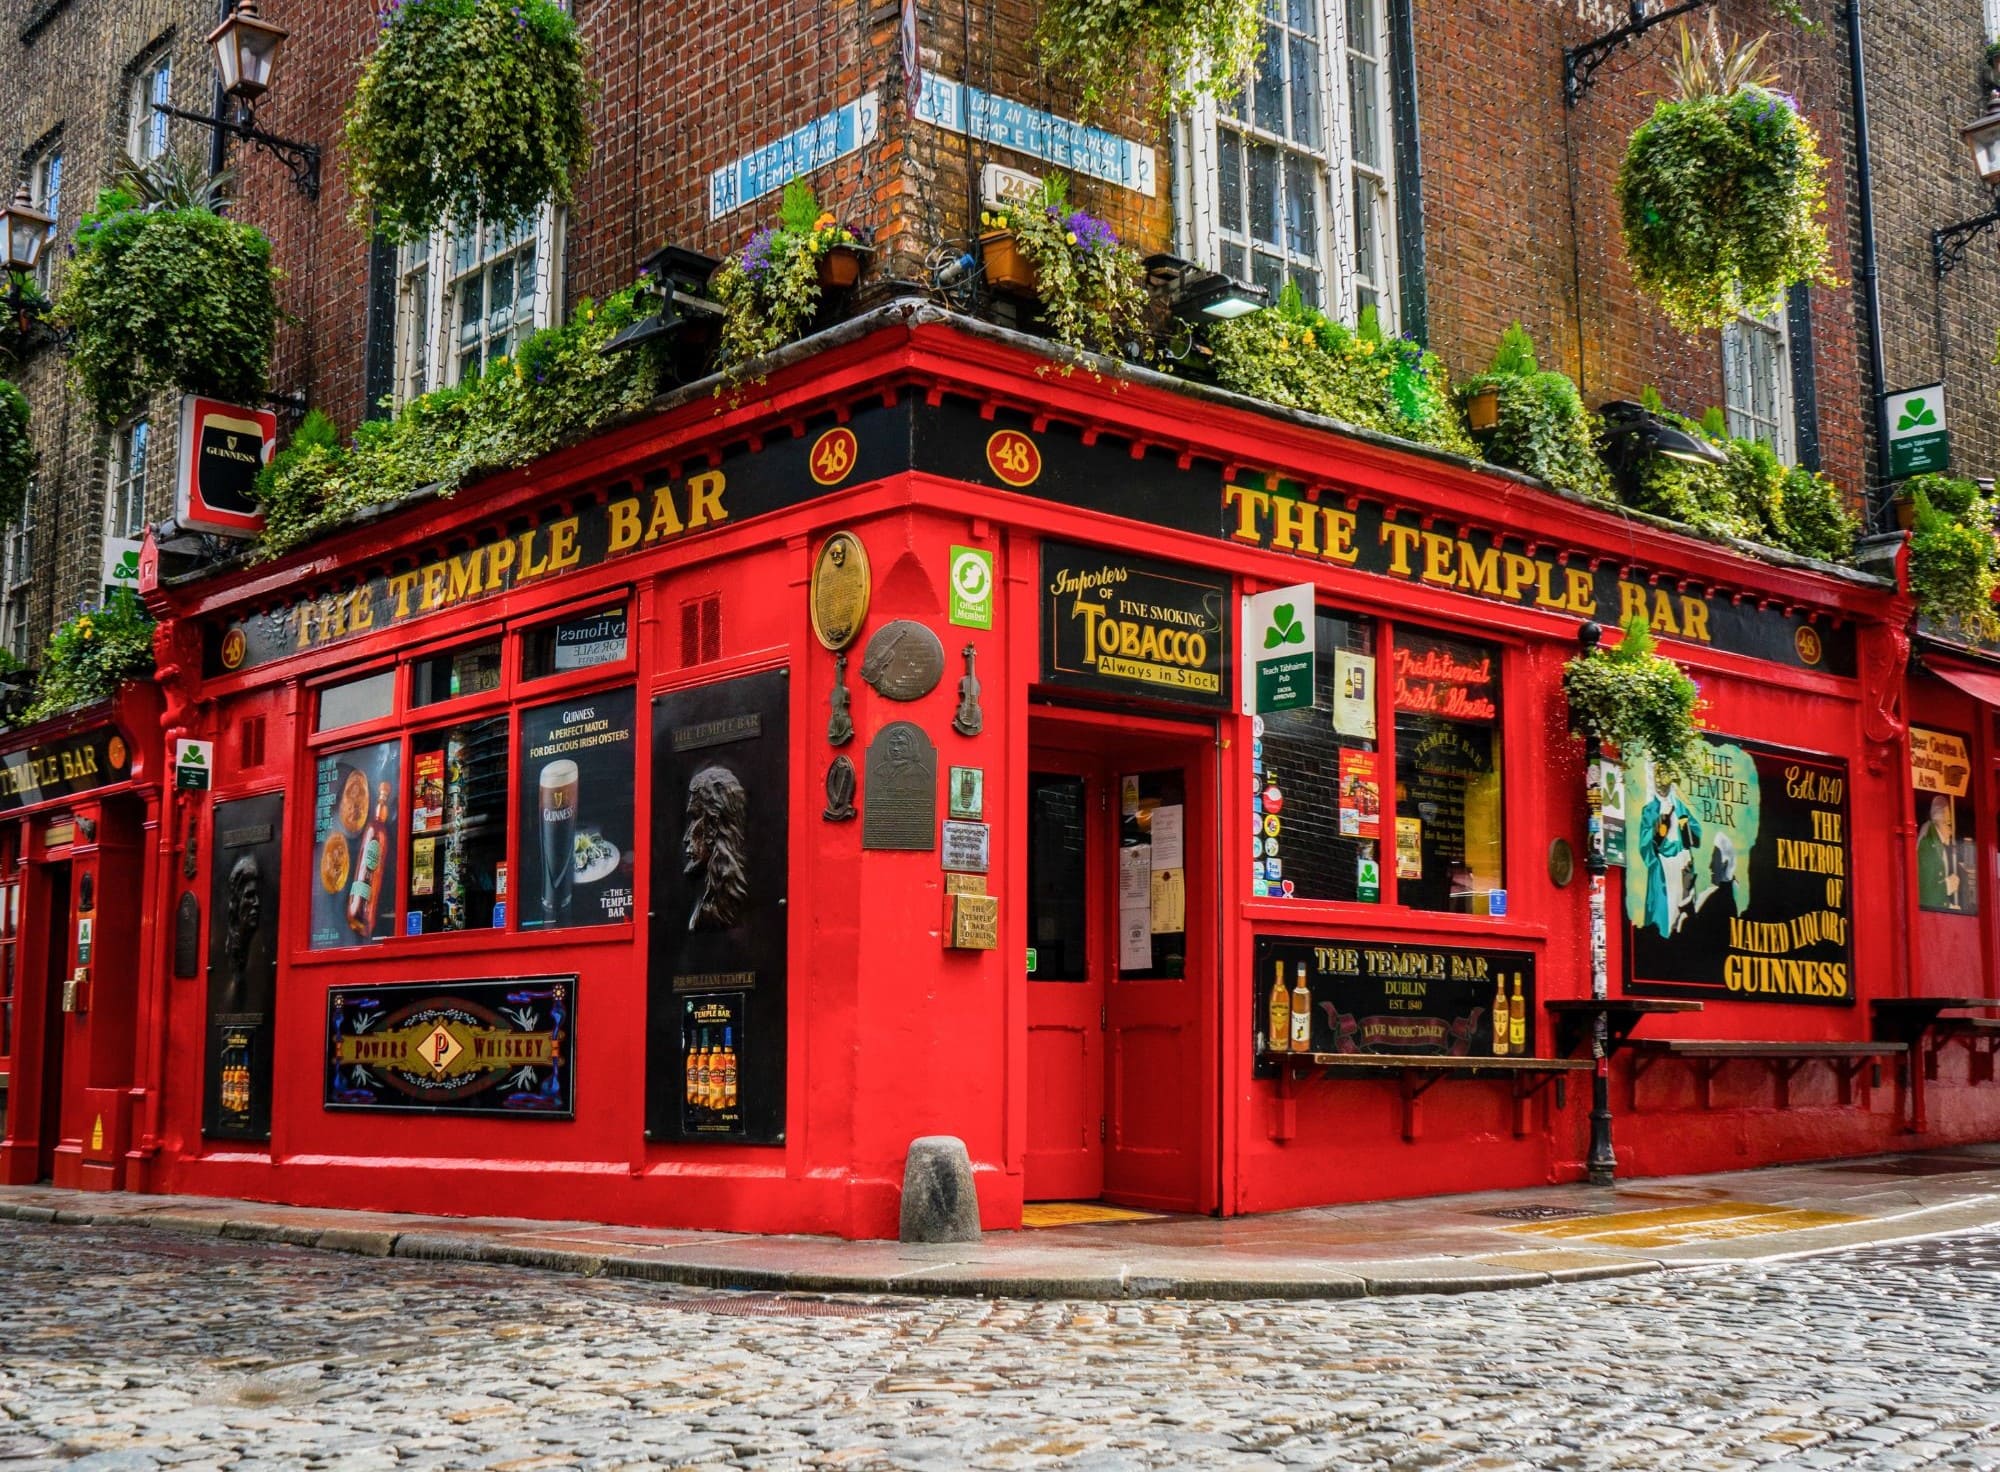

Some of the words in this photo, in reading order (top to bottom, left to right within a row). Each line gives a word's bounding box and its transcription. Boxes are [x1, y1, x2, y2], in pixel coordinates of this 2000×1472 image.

[862, 107, 872, 131] 2
[1004, 107, 1022, 125] AN
[970, 114, 1025, 146] TEMPLE
[1030, 133, 1067, 161] LANE
[1073, 150, 1122, 179] SOUTH
[758, 156, 805, 190] TEMPLE
[809, 140, 836, 166] BAR
[206, 446, 255, 463] GUINNESS
[816, 438, 848, 476] 48
[996, 437, 1029, 473] 48
[290, 583, 375, 648] THE
[389, 515, 581, 620] TEMPLE
[607, 469, 729, 553] BAR
[1224, 484, 1359, 566] THE
[1380, 521, 1597, 617] TEMPLE
[1616, 579, 1712, 643] BAR
[1051, 565, 1128, 601] Importers
[1099, 587, 1113, 600] OF
[957, 609, 986, 621] Member
[959, 600, 984, 612] Official
[1119, 599, 1148, 619] FINE
[1150, 605, 1206, 628] SMOKING
[1072, 600, 1207, 668] TOBACCO
[1798, 632, 1815, 657] 48
[224, 636, 241, 661] 48
[1101, 657, 1152, 678] Always
[1159, 667, 1172, 681] in
[1177, 669, 1217, 689] Stock
[1262, 666, 1278, 675] Teach
[1278, 674, 1290, 682] Pub
[1393, 648, 1491, 684] Traditional
[1394, 678, 1437, 709] Irish
[1443, 687, 1495, 719] Music
[563, 707, 595, 724] GUINNESS
[549, 731, 555, 741] A
[555, 724, 584, 739] PERFECT
[584, 720, 608, 733] MATCH
[530, 747, 544, 758] FOR
[544, 739, 579, 755] DELICIOUS
[580, 736, 598, 748] IRISH
[598, 729, 630, 744] OYSTERS
[1414, 732, 1458, 757] TEMPLE
[1930, 736, 1957, 758] Garden
[0, 757, 60, 796] TEMPLE
[63, 744, 98, 781] BAR
[1911, 750, 1944, 775] Smoking
[1687, 773, 1749, 805] TEMPLE
[1818, 775, 1843, 805] 1840
[1918, 771, 1937, 789] Area
[543, 806, 573, 822] GUINNESS
[1702, 799, 1736, 829] BAR
[1811, 810, 1842, 843] THE
[1776, 838, 1844, 877] EMPEROR
[600, 895, 633, 909] TEMPLE
[610, 888, 623, 897] THE
[1825, 878, 1843, 909] OF
[608, 907, 625, 918] BAR
[966, 914, 992, 922] TEMPLE
[972, 905, 984, 913] THE
[1729, 916, 1790, 954] MALTED
[1790, 910, 1848, 949] LIQUORS
[1314, 947, 1360, 976] THE
[1365, 950, 1446, 979] TEMPLE
[1451, 956, 1491, 982] BAR
[1724, 954, 1847, 998] GUINNESS
[1384, 981, 1427, 996] DUBLIN
[694, 1010, 716, 1019] TEMPLE
[717, 1009, 731, 1018] BAR
[1364, 1023, 1387, 1038] LIVE
[1388, 1024, 1417, 1038] MUSIC
[1418, 1024, 1446, 1038] DAILY
[355, 1039, 407, 1059] POWERS
[434, 1032, 449, 1067] P
[473, 1036, 543, 1059] WHISKEY
